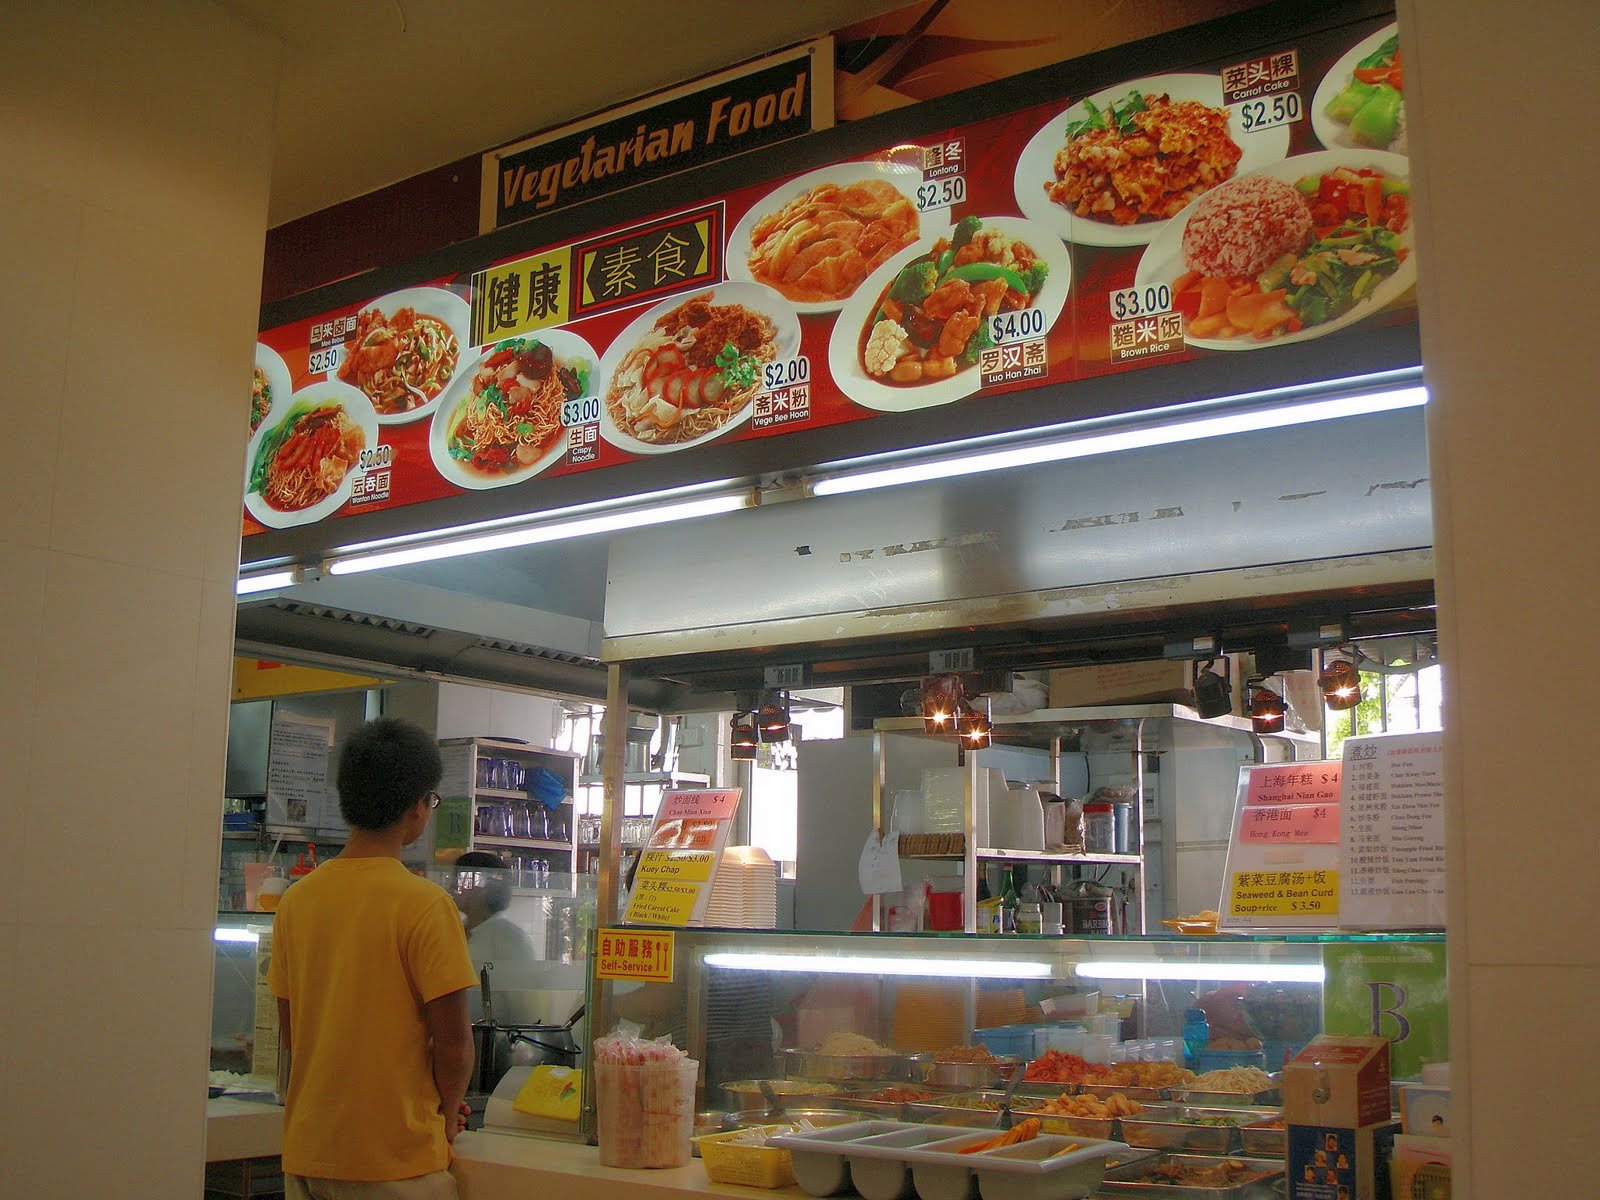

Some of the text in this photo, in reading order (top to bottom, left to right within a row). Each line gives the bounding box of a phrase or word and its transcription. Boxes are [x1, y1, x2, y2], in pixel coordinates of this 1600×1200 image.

[1225, 54, 1294, 90] 菜头粿
[1232, 80, 1290, 100] Carrot Cake
[1241, 93, 1299, 133] $2.50
[503, 72, 807, 210] Vegetarian Food
[929, 164, 959, 178] Lontong
[916, 177, 964, 212] $2.50
[487, 232, 691, 335] 健康 素食
[1115, 284, 1170, 321] $3.00
[993, 308, 1043, 344] $4.00
[1112, 315, 1182, 348] 糙米饭
[309, 349, 337, 373] $2.50
[981, 342, 1045, 373] 罗汉斋
[1120, 343, 1170, 358] Brown Rice
[765, 357, 808, 389] $2.00
[988, 365, 1042, 383] Luo Han Zhai
[563, 398, 599, 425] $3.00
[755, 388, 808, 415] 斋米粉
[754, 410, 809, 426] Vege Bee Hoon
[569, 425, 598, 446] 生面
[360, 445, 390, 470] $2.50
[572, 446, 593, 455] Crispy
[572, 453, 596, 463] Noodle
[353, 474, 389, 494] 云吞面
[1257, 791, 1334, 803] Shanghai Nian Gao
[1253, 808, 1292, 822] 香港面
[1312, 807, 1327, 819] $4
[1249, 829, 1269, 839] Hong
[1271, 829, 1291, 838] Kong
[640, 865, 680, 875] Kuey Chap
[1235, 888, 1334, 900] Seaweed & Bean Curd
[1234, 903, 1278, 914] Soup+rice
[602, 937, 653, 959] 自助服務
[601, 959, 653, 973] Self-Service
[1363, 981, 1411, 1044] B
